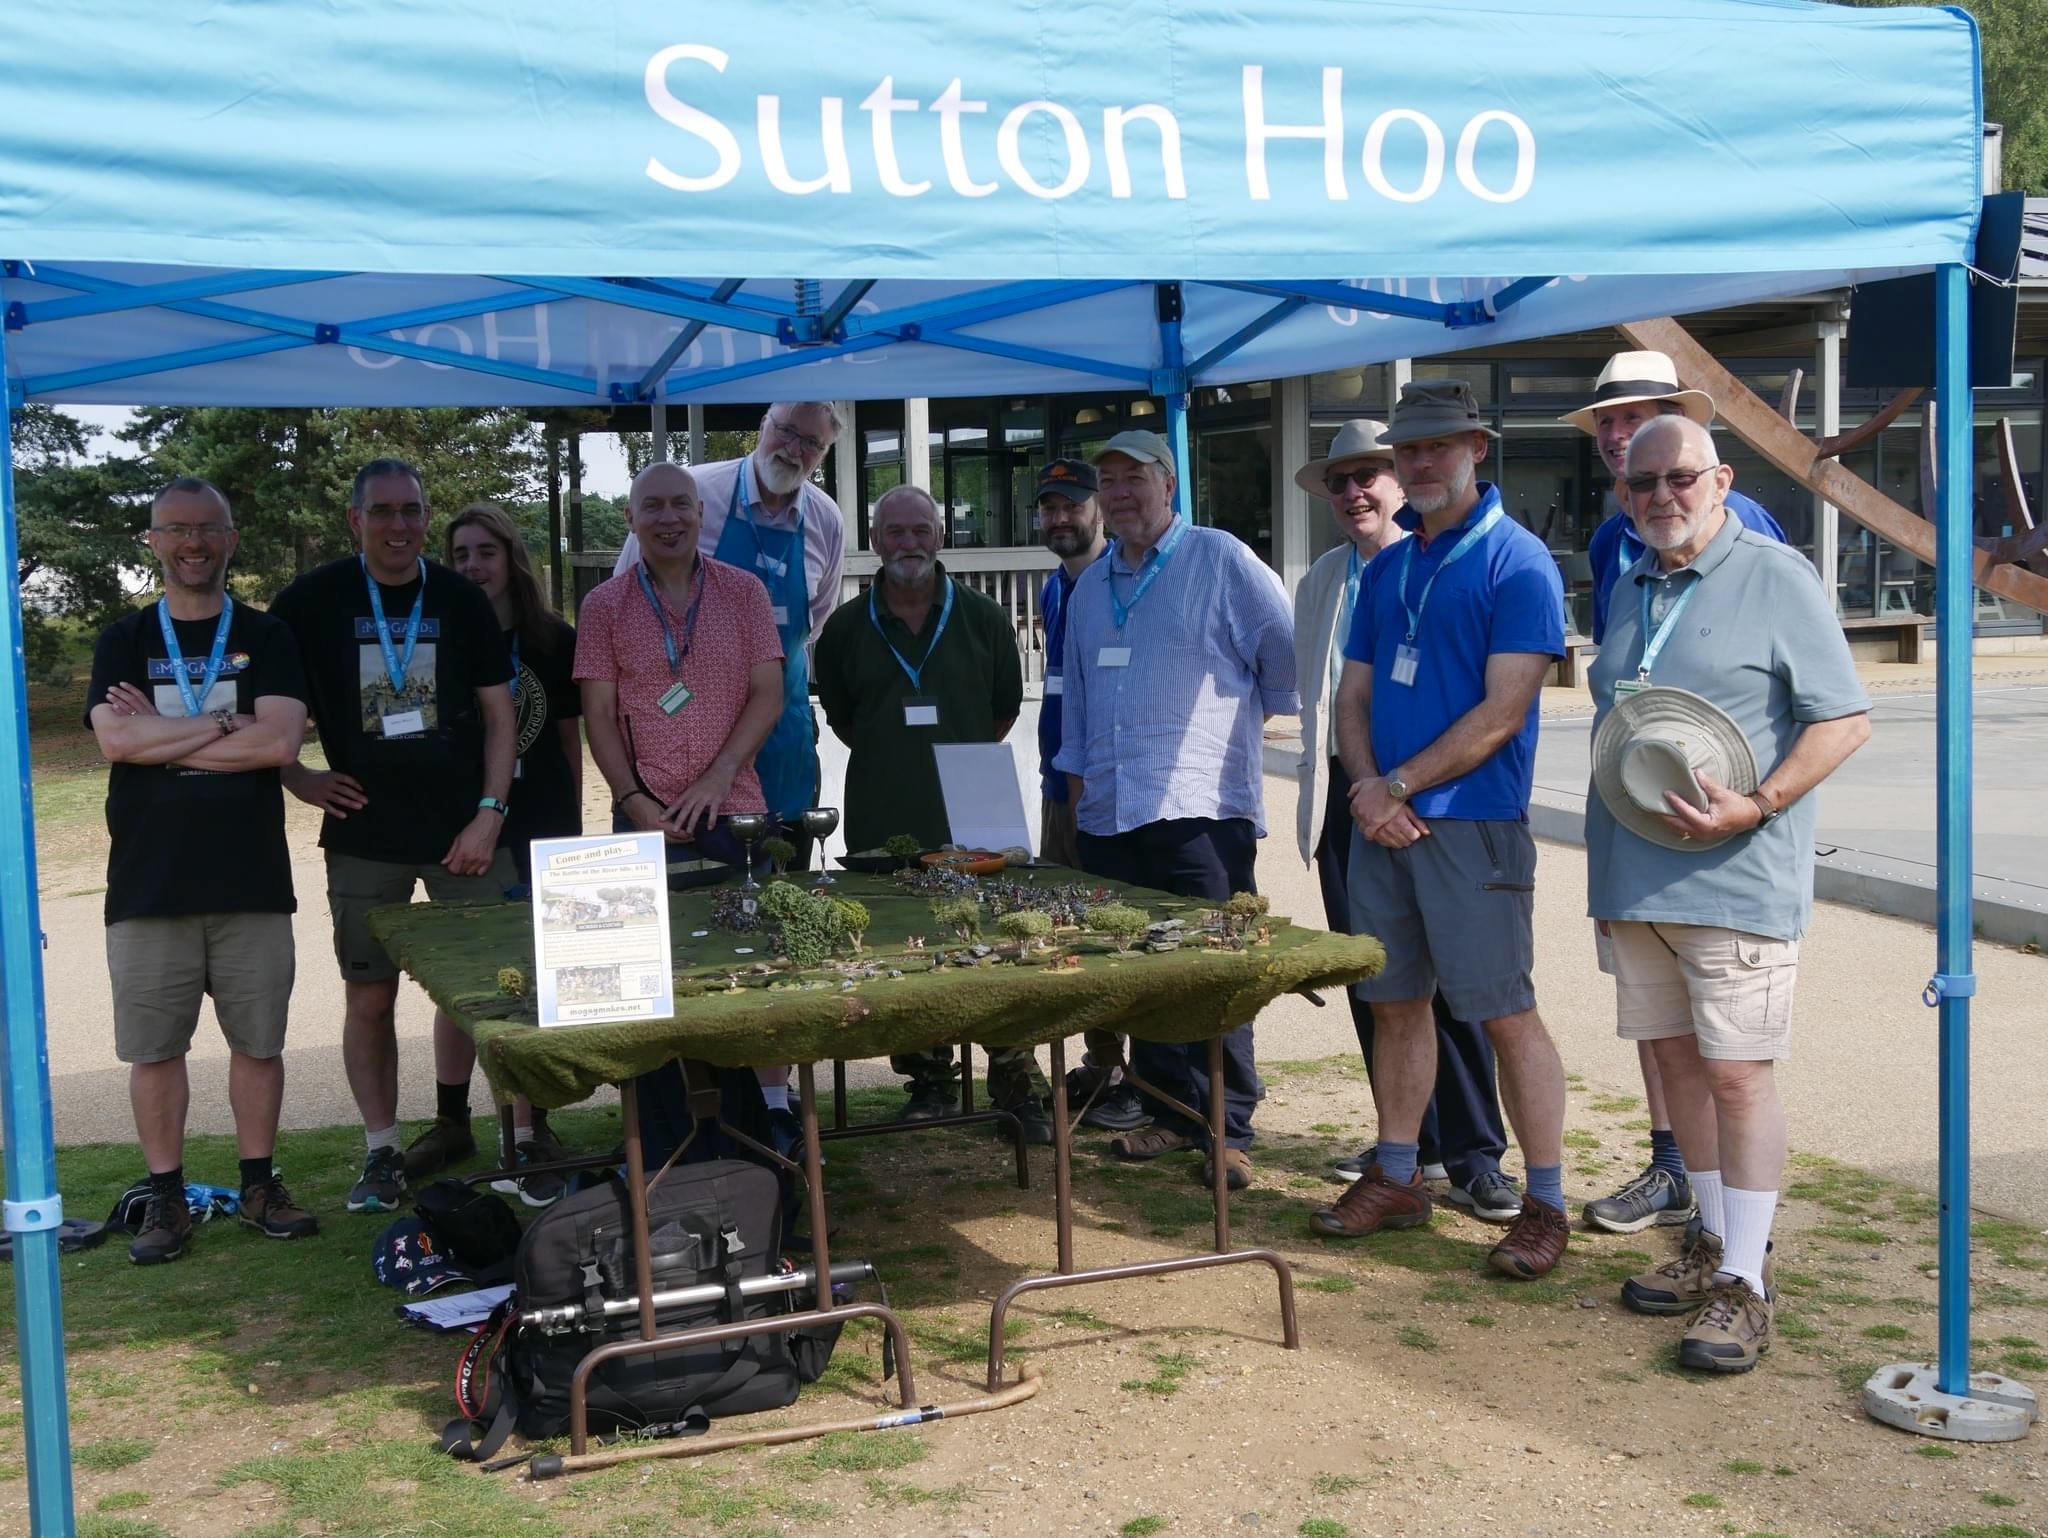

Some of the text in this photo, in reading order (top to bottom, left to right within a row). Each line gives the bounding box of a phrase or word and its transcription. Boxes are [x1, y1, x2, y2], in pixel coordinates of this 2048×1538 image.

[643, 43, 1537, 204] Sutton Hoo
[556, 854, 582, 865] Come
[584, 850, 602, 859] and
[462, 1361, 474, 1377] 7D
